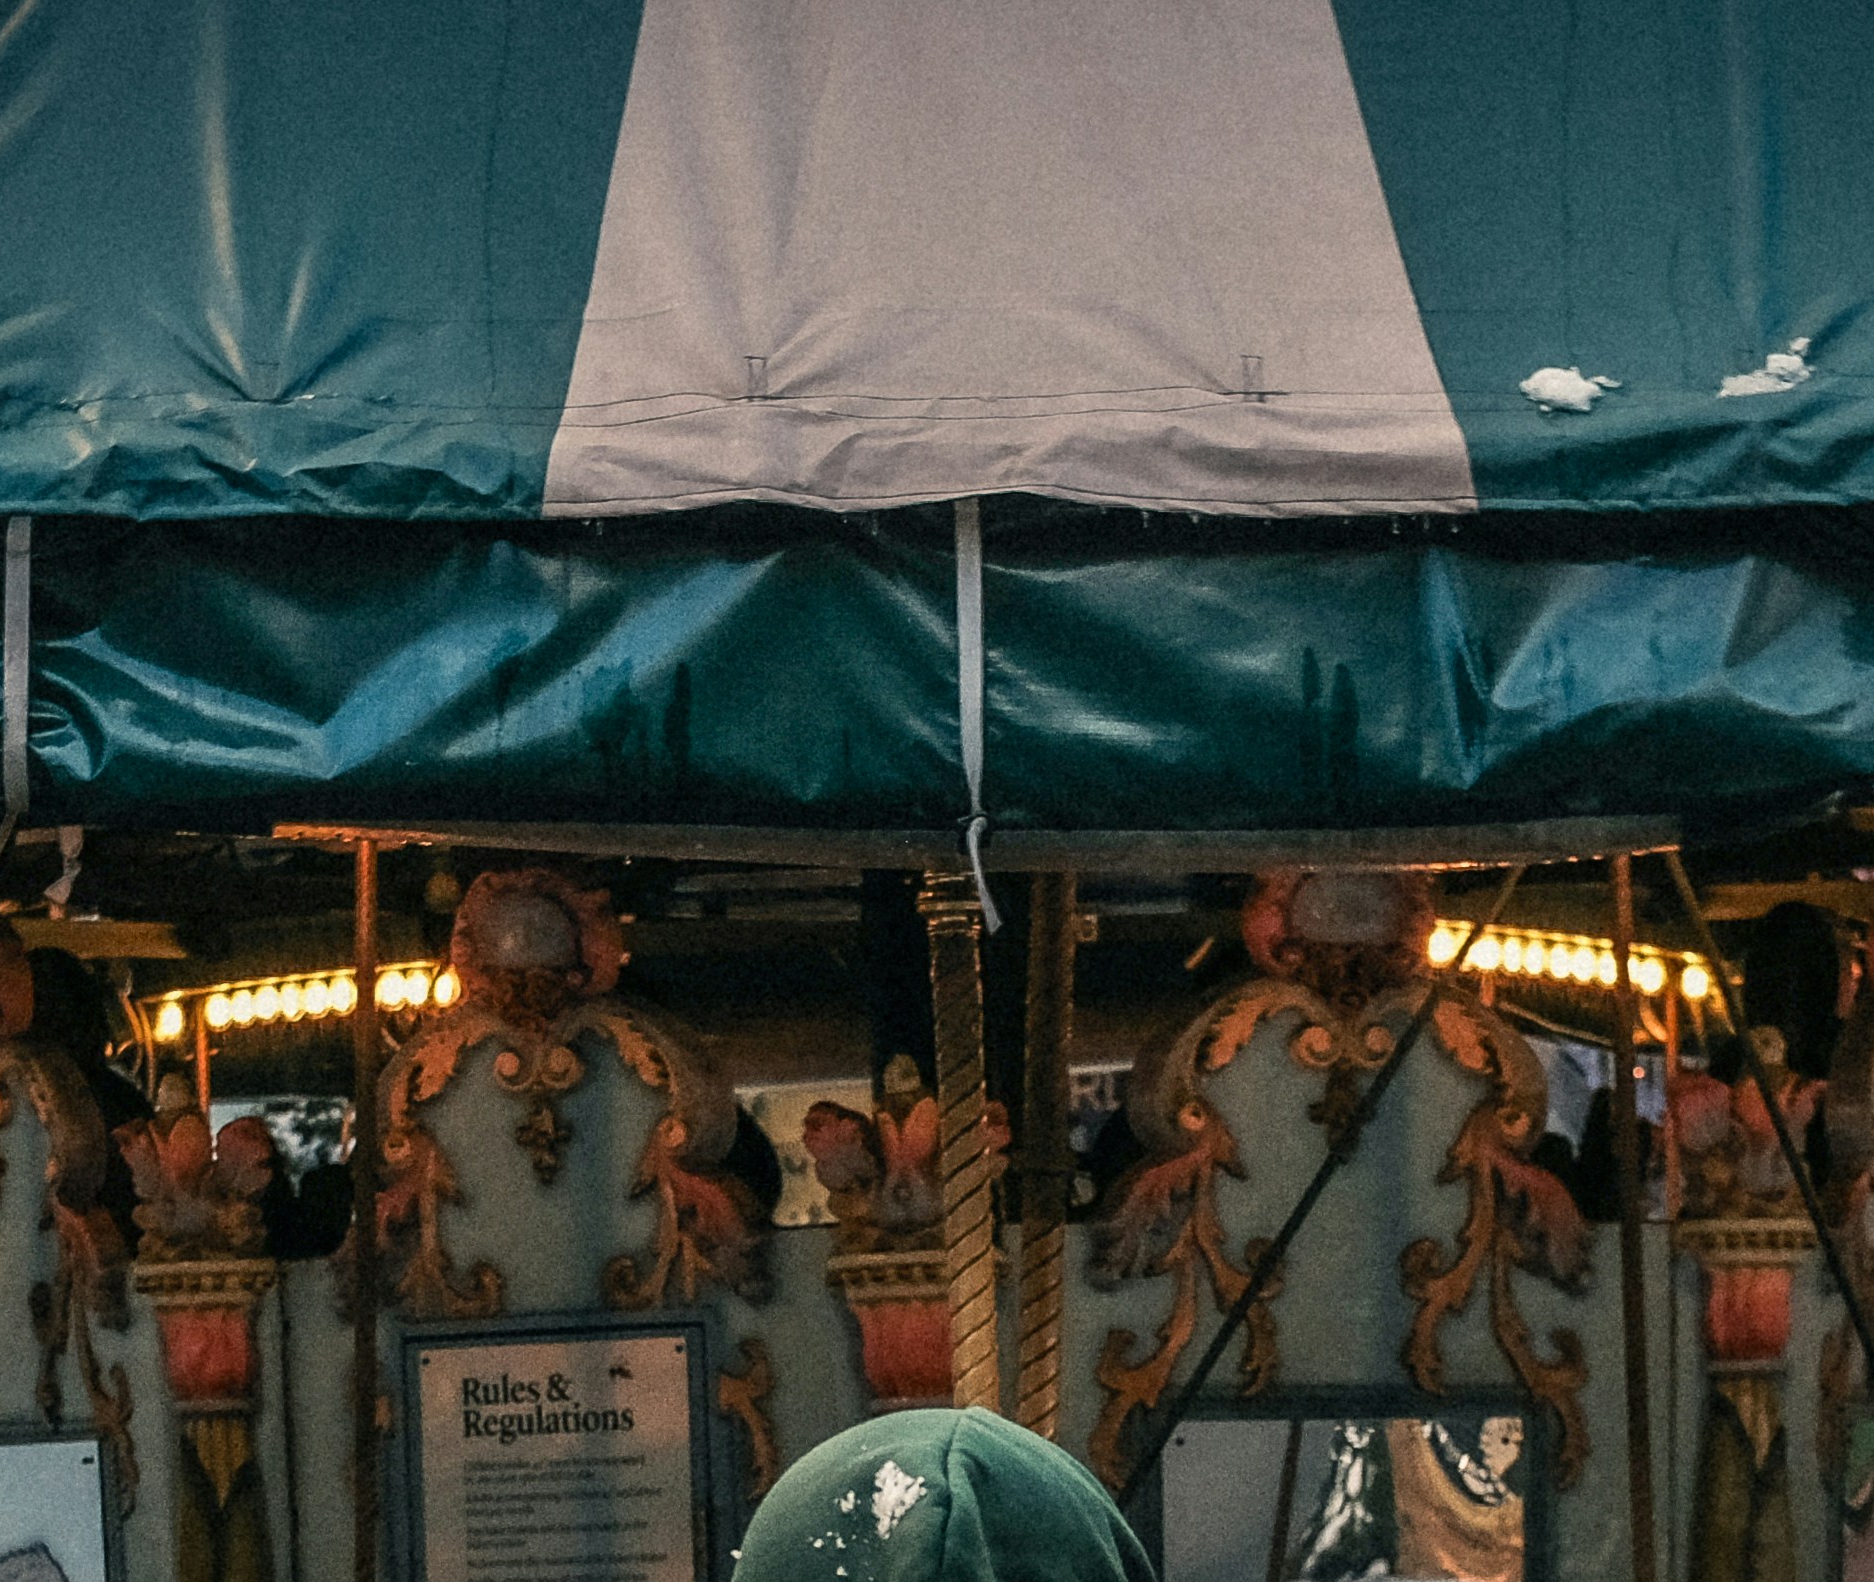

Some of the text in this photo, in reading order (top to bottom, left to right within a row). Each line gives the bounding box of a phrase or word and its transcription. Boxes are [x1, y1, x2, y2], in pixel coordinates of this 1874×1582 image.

[462, 1373, 571, 1406] Rules &
[463, 1403, 634, 1444] Regulations
